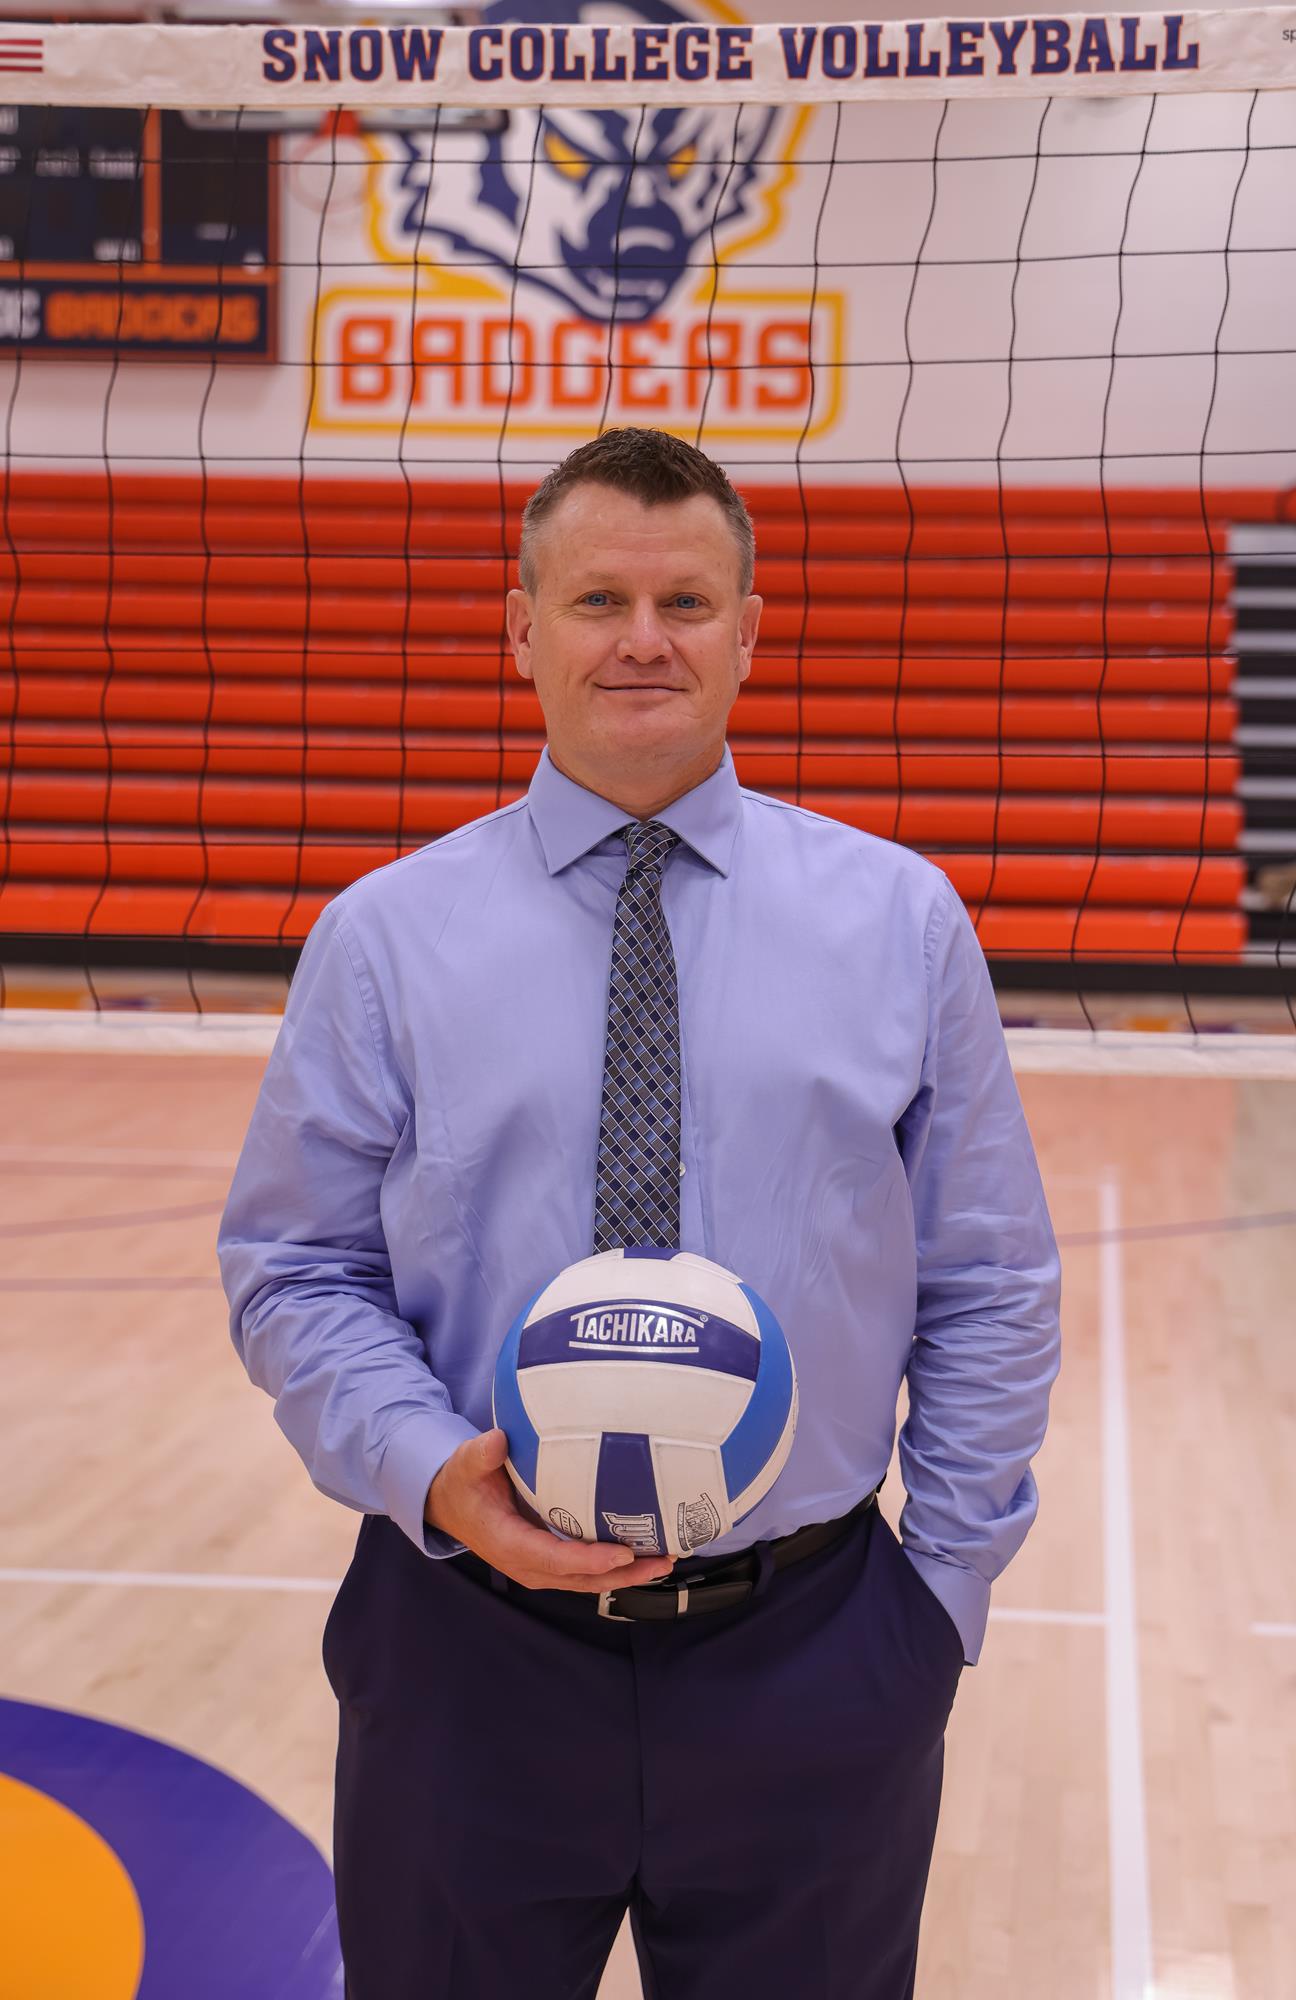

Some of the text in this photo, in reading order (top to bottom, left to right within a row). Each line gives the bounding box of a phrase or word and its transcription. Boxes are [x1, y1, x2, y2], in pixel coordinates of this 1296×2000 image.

[262, 14, 1200, 82] SNOW COLLEGE VOLLEYBALL
[339, 317, 817, 410] BADGERS
[570, 1304, 704, 1343] TACHIKARA
